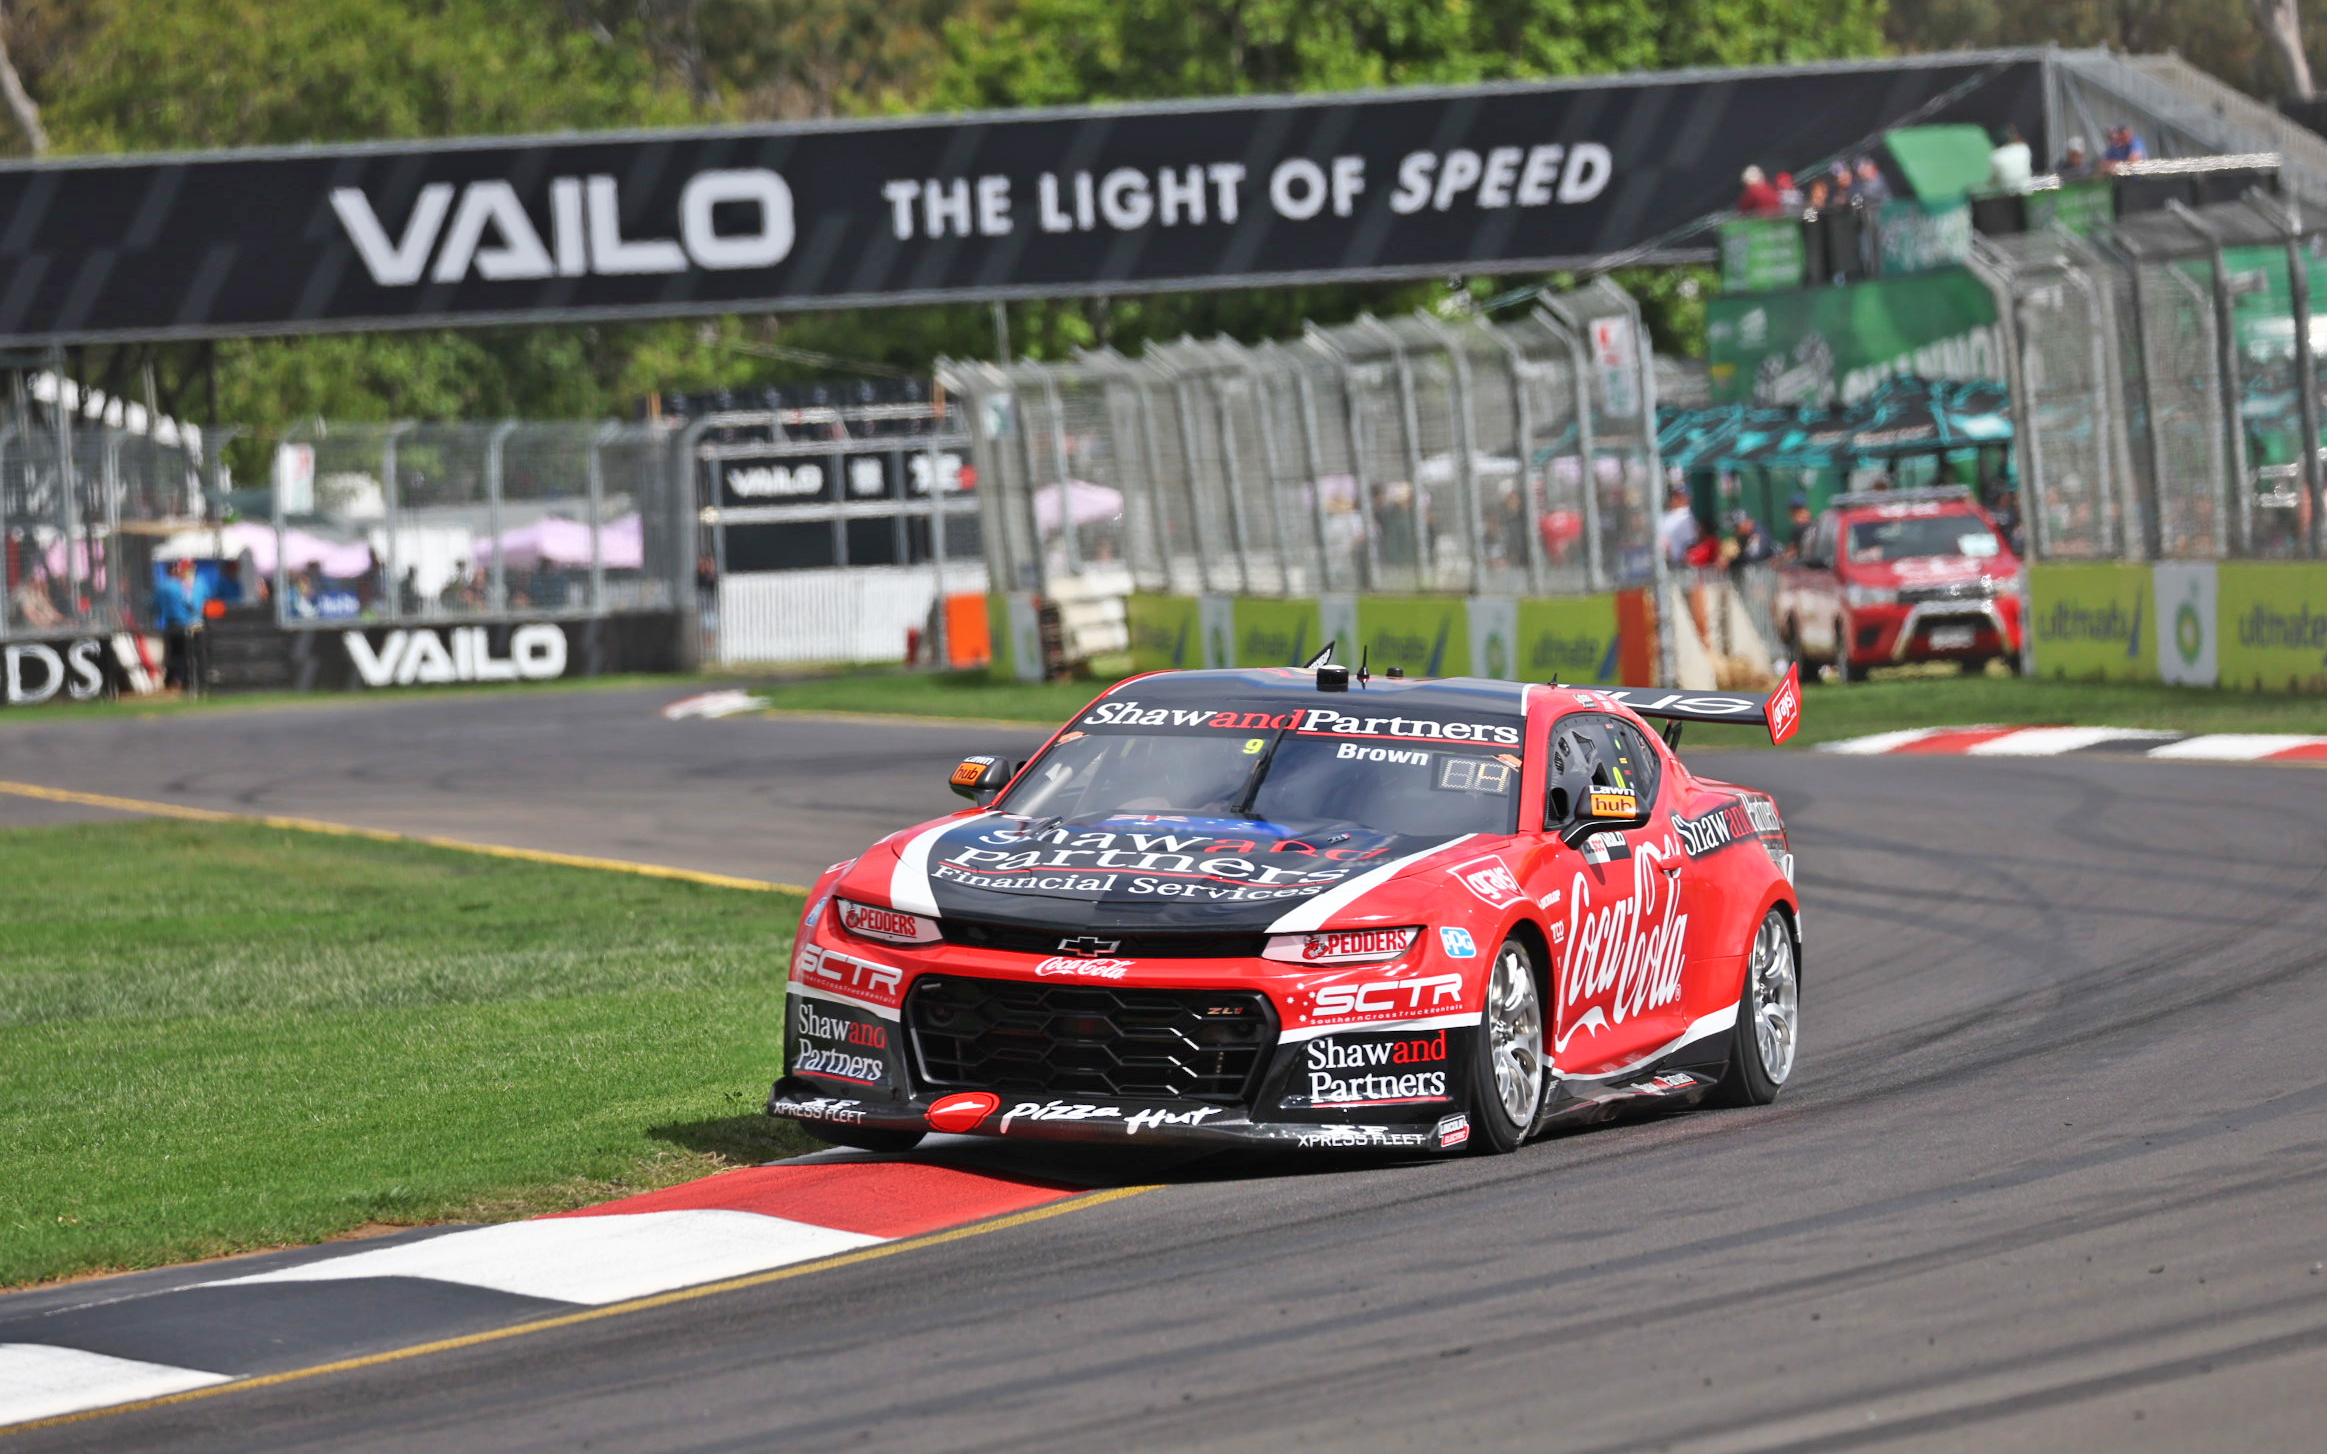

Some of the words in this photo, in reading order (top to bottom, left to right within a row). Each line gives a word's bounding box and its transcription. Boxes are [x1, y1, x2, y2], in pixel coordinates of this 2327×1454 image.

[331, 168, 796, 286] VAILO
[884, 178, 1013, 241] THE
[1038, 161, 1243, 233] LIGHT
[1269, 156, 1365, 219] OF
[1391, 142, 1612, 212] SPEED
[343, 623, 568, 686] VAILO
[1242, 738, 1264, 755] 9
[1336, 743, 1429, 766] Brown
[954, 765, 979, 780] hub
[1589, 785, 1635, 796] Lawn
[1595, 797, 1632, 812] hub
[945, 845, 1352, 884] Partners
[930, 864, 1115, 893] Financial
[1128, 876, 1324, 900] Services
[859, 908, 917, 936] PEDDERS
[1327, 929, 1407, 954] PEDDERS
[1442, 930, 1473, 955] PPG
[801, 943, 903, 996] SCTR
[1312, 973, 1463, 1016] SCTR
[794, 1038, 883, 1080] Partners
[1308, 1071, 1446, 1103] Partners
[774, 1102, 821, 1119] XPRESS
[825, 1108, 866, 1124] FLEET
[1297, 1134, 1367, 1147] XPRESS
[1371, 1134, 1425, 1146] FLEET
